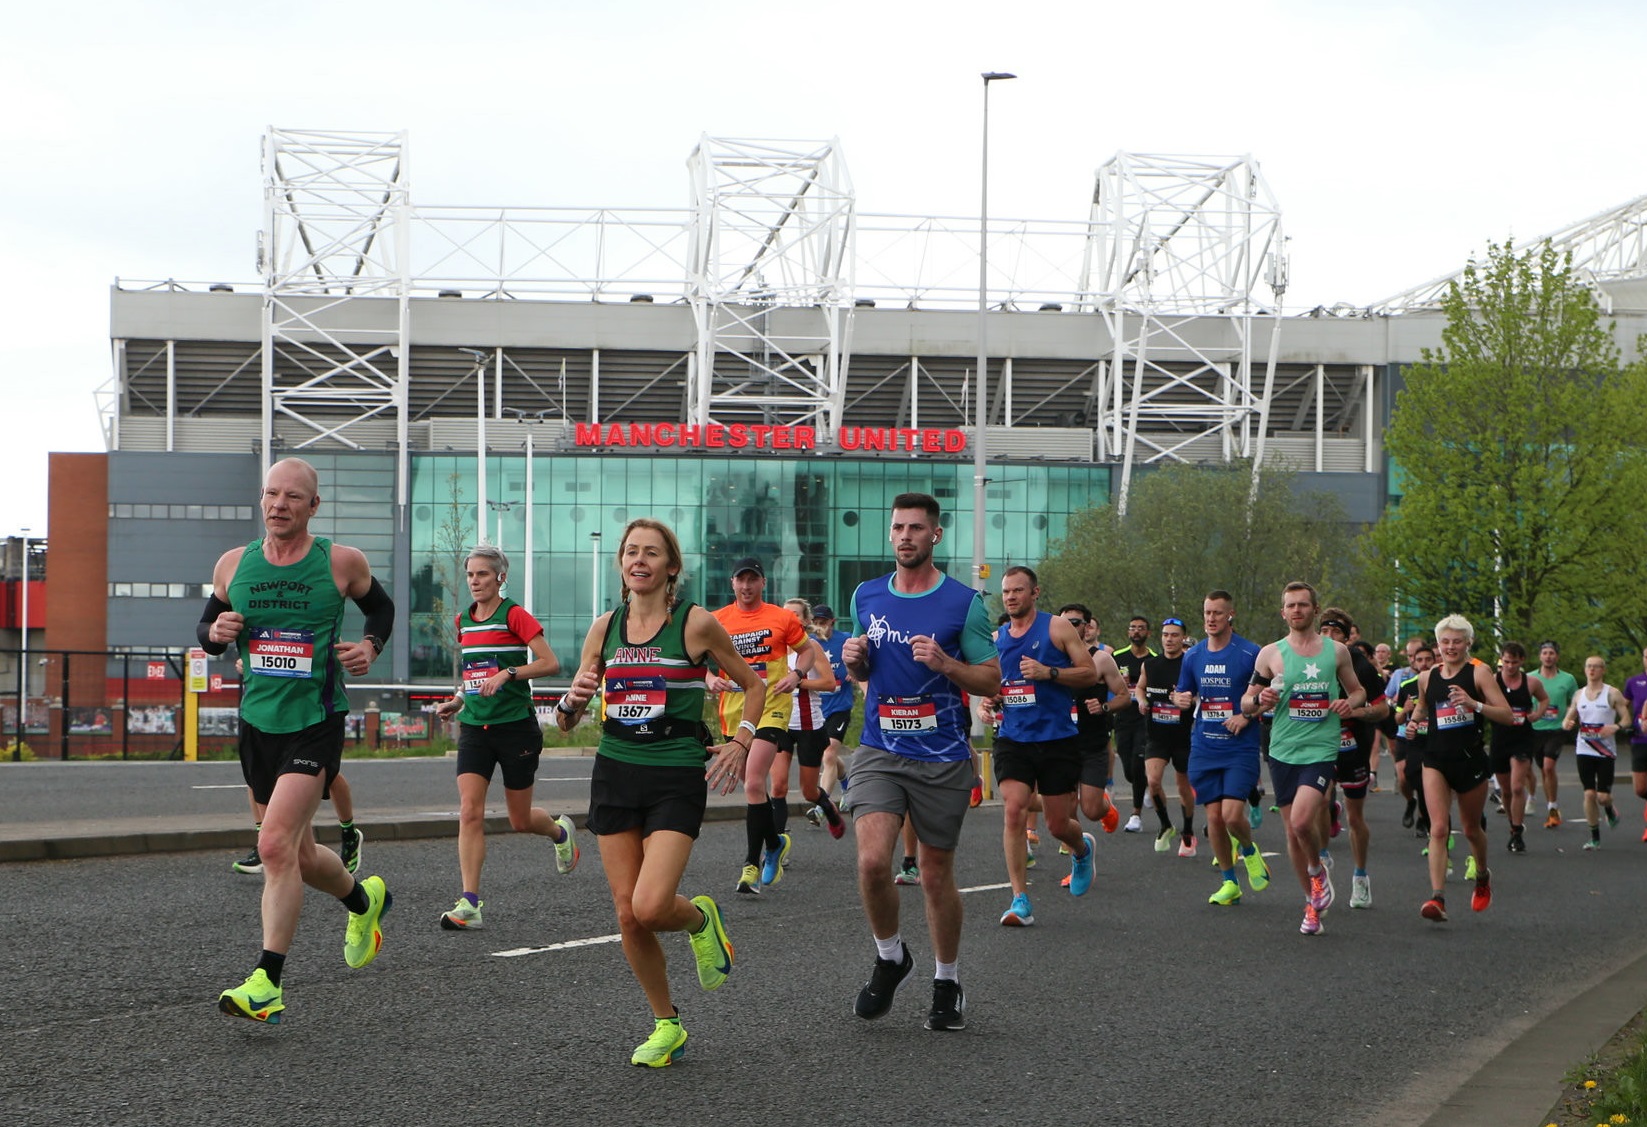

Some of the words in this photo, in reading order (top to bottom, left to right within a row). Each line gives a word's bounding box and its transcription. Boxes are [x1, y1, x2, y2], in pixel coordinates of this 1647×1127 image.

[575, 423, 815, 449] MANCHESTER
[839, 426, 967, 453] UNITED
[249, 580, 313, 595] NEWPORT
[248, 599, 311, 610] DISTRICT
[256, 644, 304, 654] JONATHAN
[613, 647, 662, 663] ANNE
[260, 656, 297, 669] 15010
[1204, 664, 1226, 674] ADAM
[1200, 677, 1232, 685] HOSPICE
[1292, 682, 1330, 691] SAYSKY
[625, 694, 647, 702] ANNE
[1006, 695, 1028, 703] 15086
[618, 705, 652, 718] 13677
[1296, 709, 1323, 717] 15200
[890, 718, 922, 730] 15173
